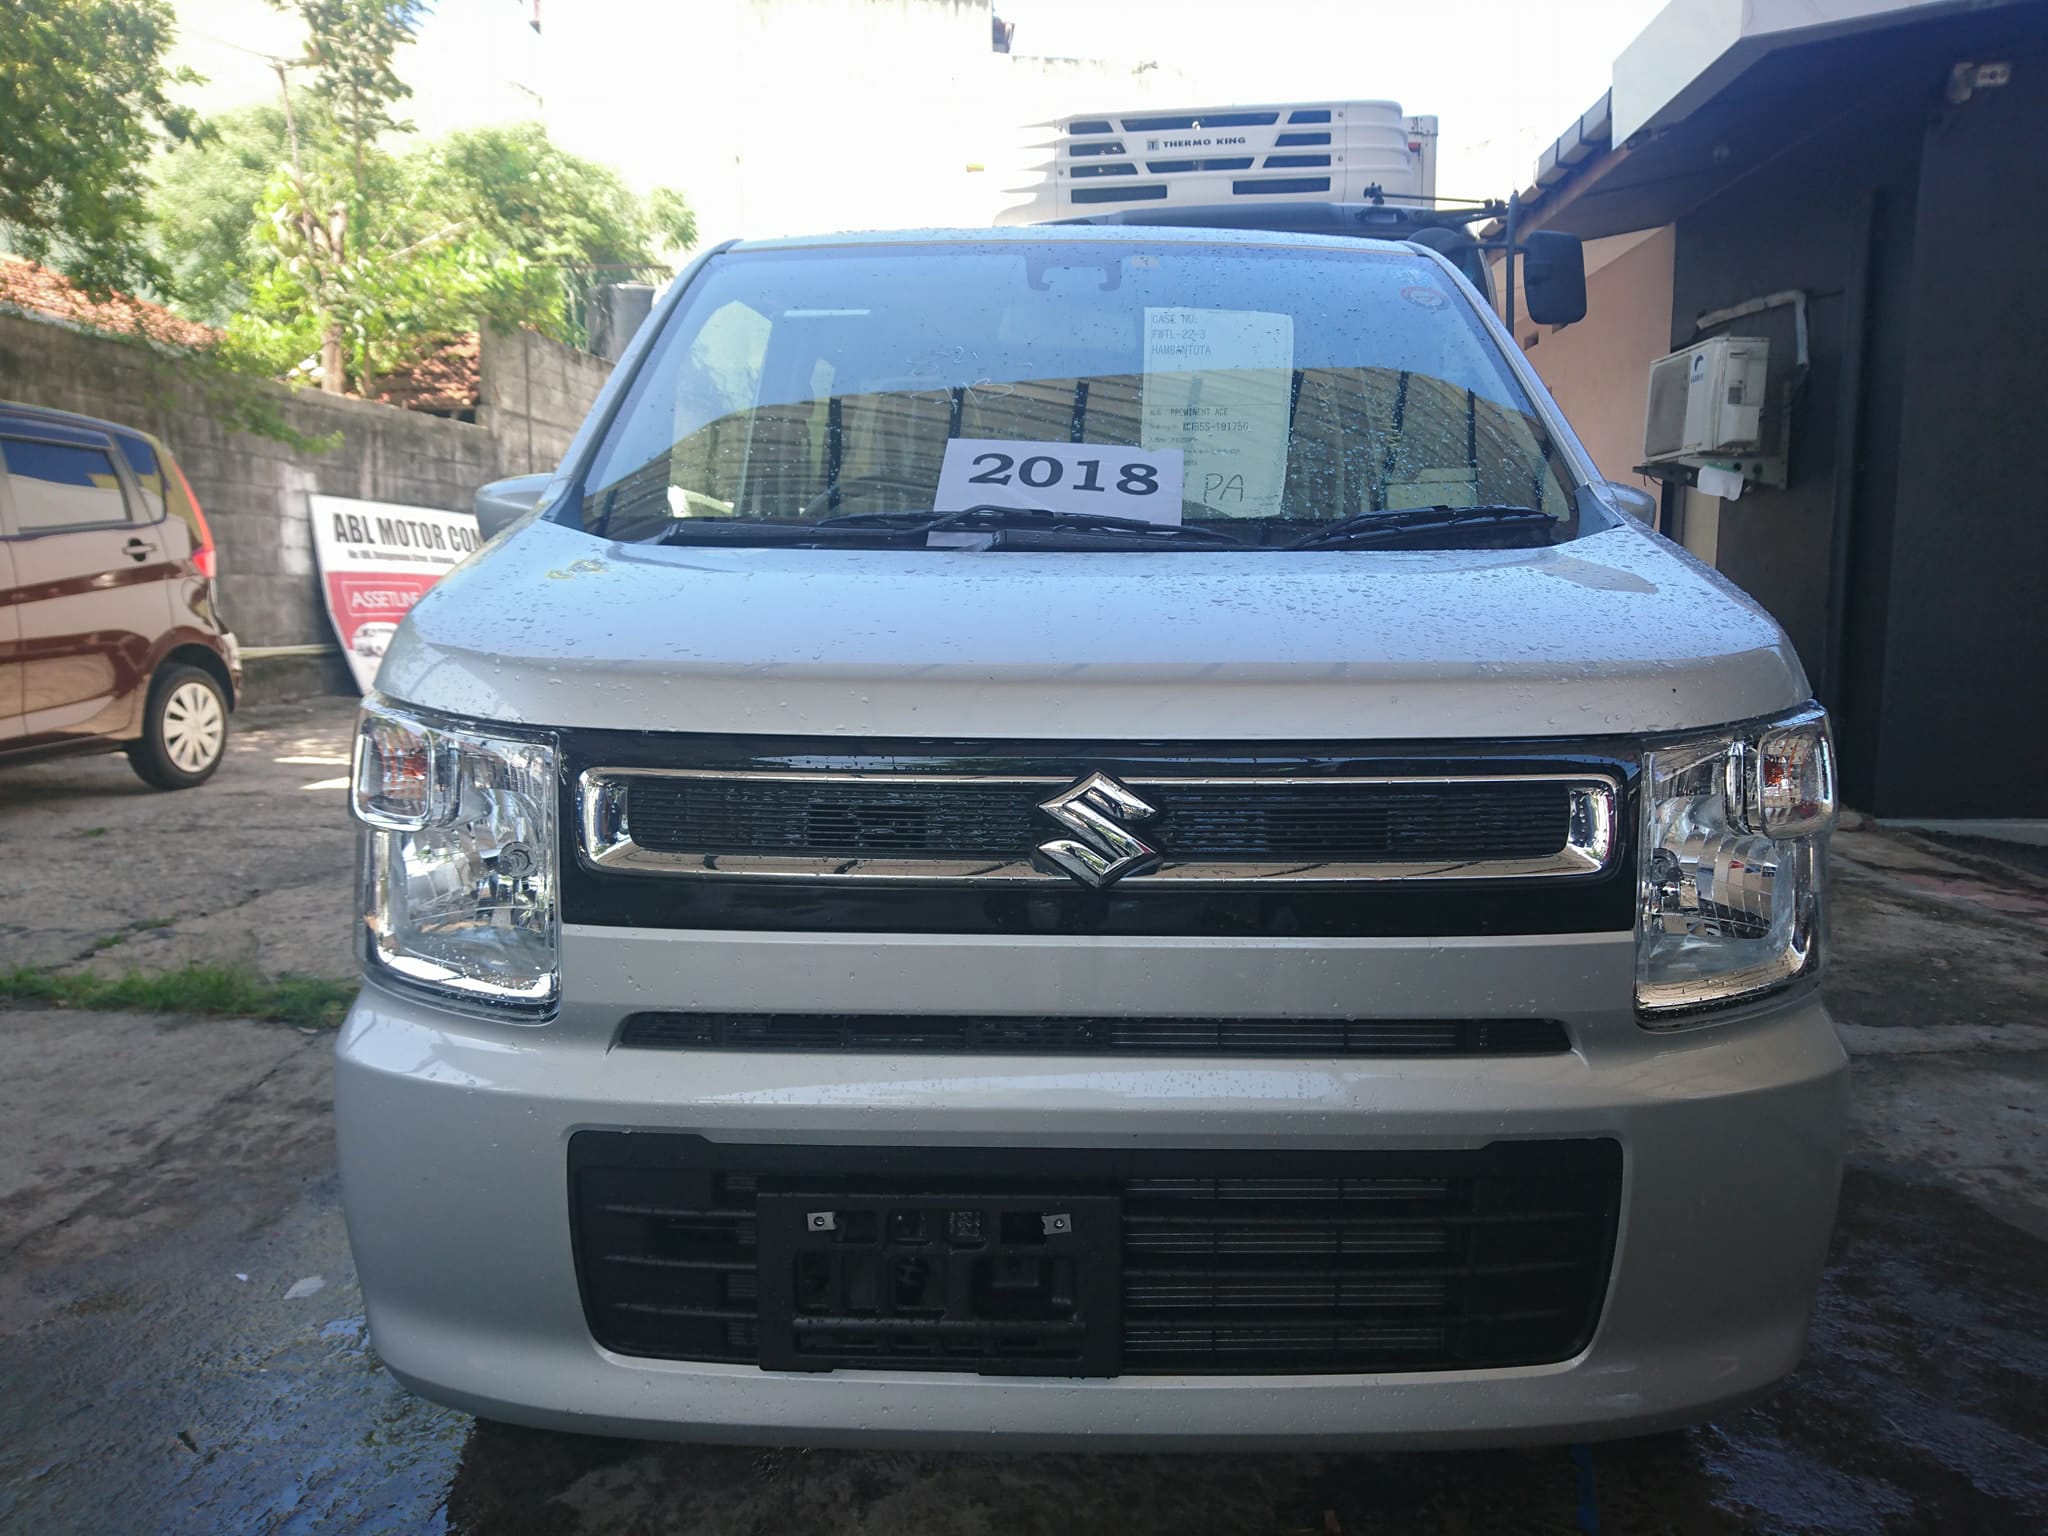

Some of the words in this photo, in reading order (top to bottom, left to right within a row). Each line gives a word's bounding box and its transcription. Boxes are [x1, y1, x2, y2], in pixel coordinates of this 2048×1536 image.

[1163, 138, 1212, 148] THERMO
[1216, 136, 1246, 145] KING
[1152, 314, 1176, 324] CASE
[968, 453, 1159, 496] 2018
[1203, 473, 1244, 504] PA
[333, 512, 375, 544] ABL
[376, 517, 446, 551] MOTOR
